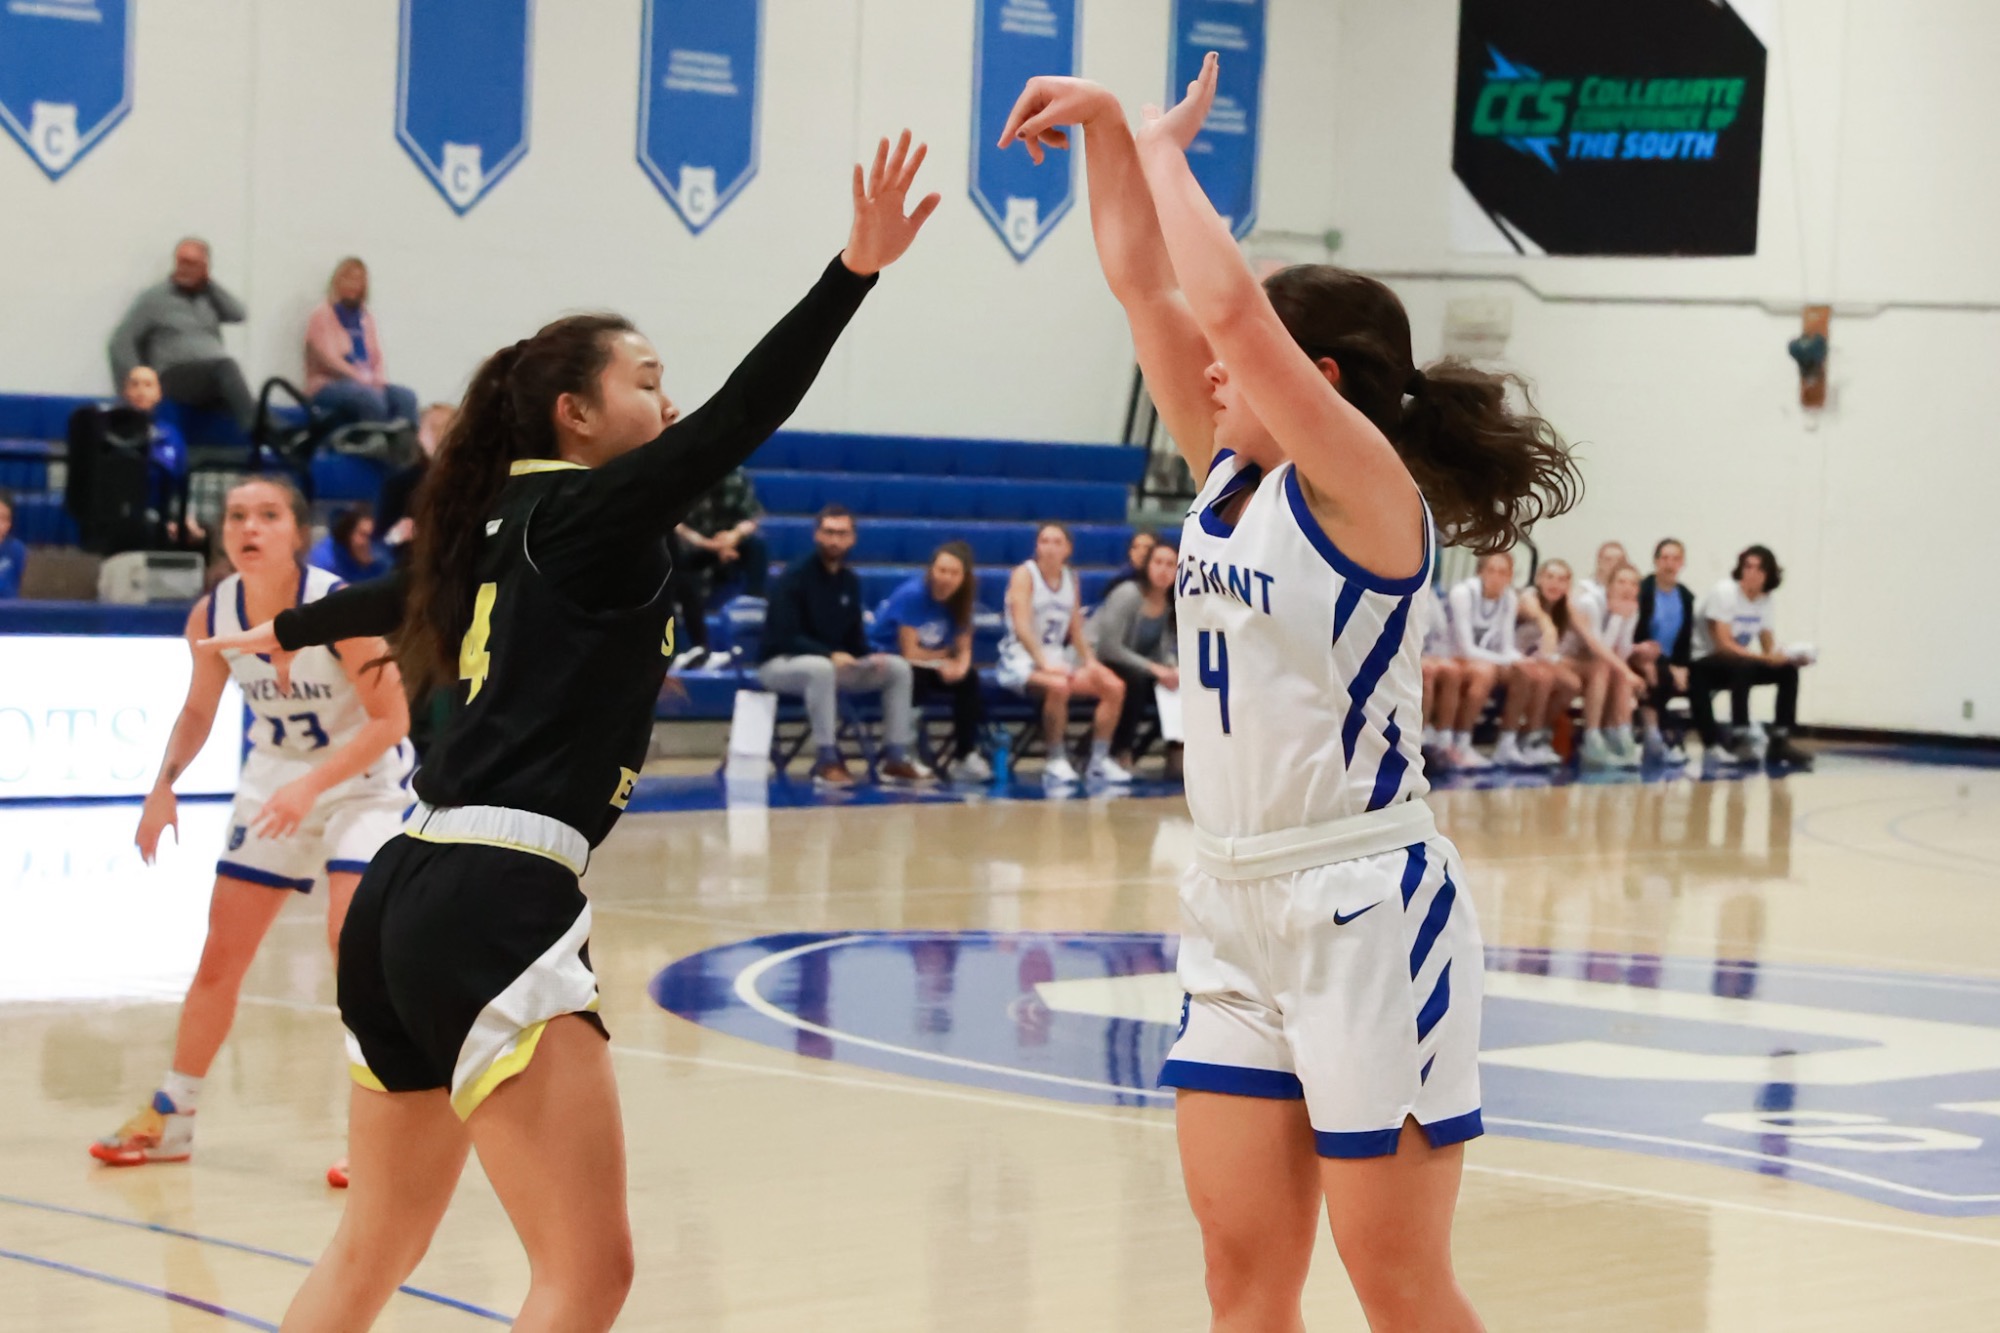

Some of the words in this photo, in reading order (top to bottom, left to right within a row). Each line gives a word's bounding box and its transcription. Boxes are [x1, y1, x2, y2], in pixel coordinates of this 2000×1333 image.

[1472, 80, 1572, 136] CCS
[1568, 131, 1621, 159] THE
[1621, 131, 1717, 159] SOUTH
[1198, 628, 1231, 737] 4
[264, 711, 330, 750] 13
